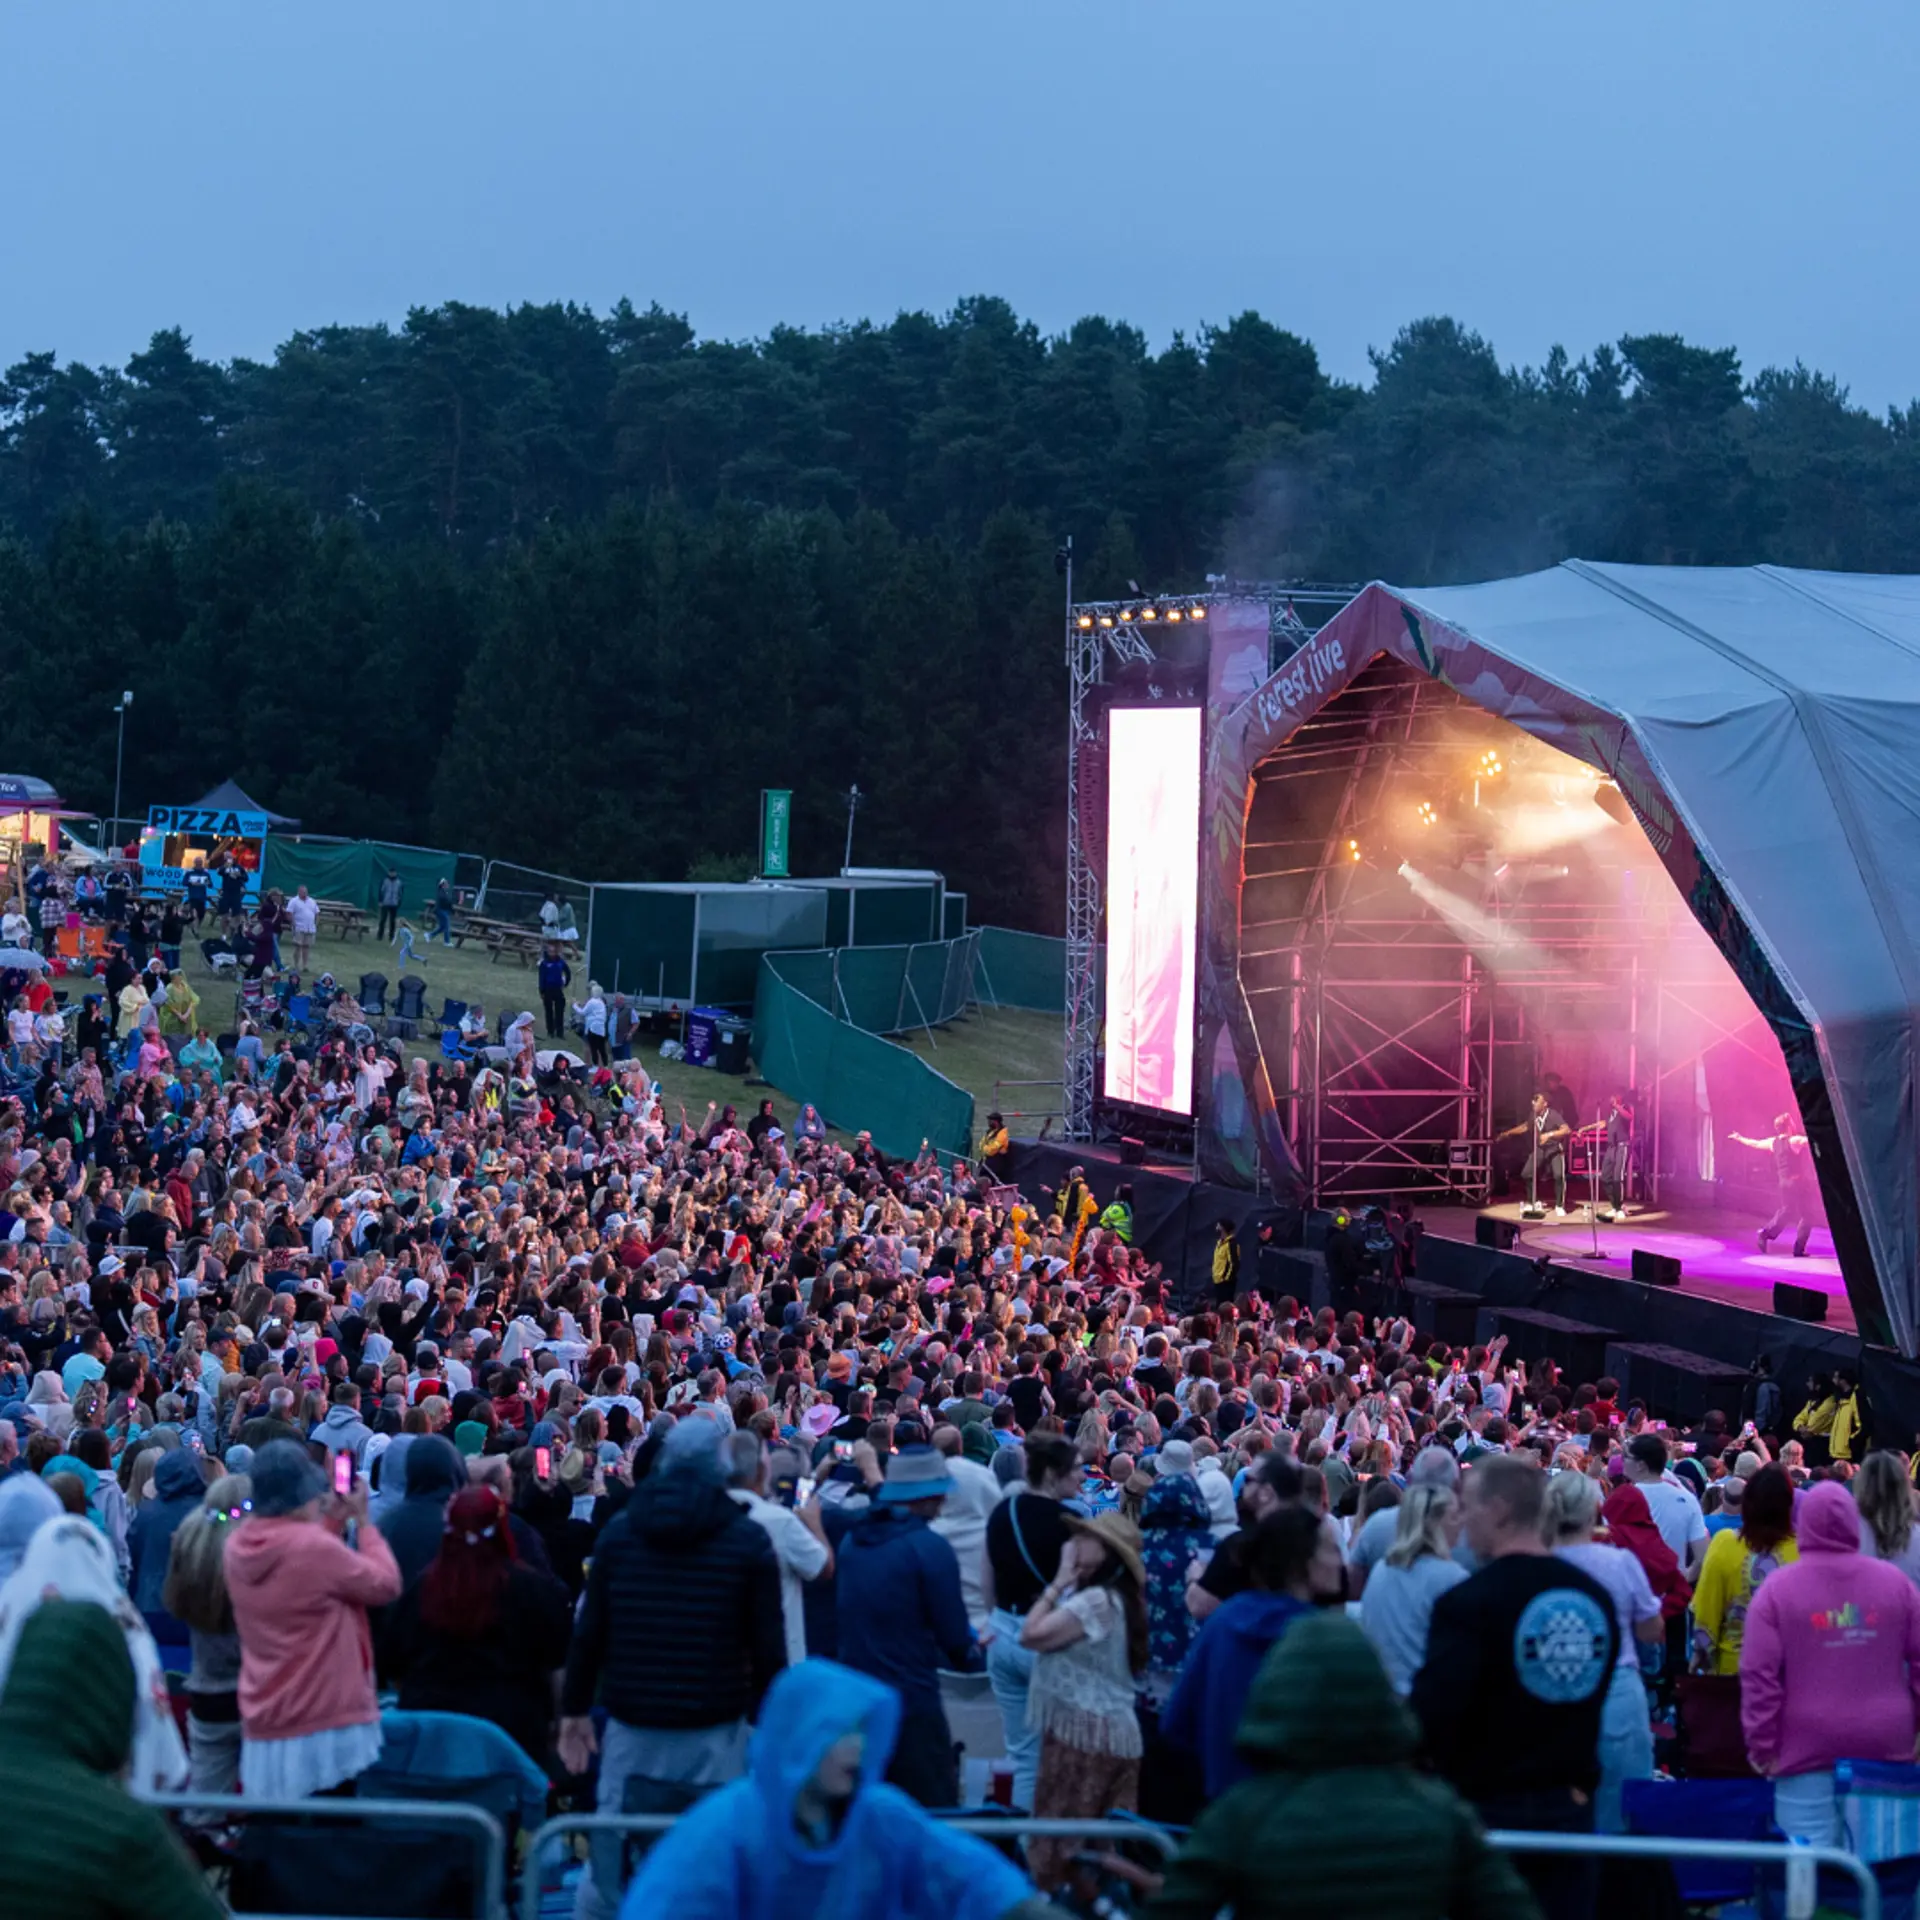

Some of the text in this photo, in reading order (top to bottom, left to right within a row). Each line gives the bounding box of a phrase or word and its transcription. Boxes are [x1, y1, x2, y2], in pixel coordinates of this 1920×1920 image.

[1307, 639, 1346, 694] live
[150, 808, 242, 834] PIZZA
[146, 868, 182, 878] WOOD
